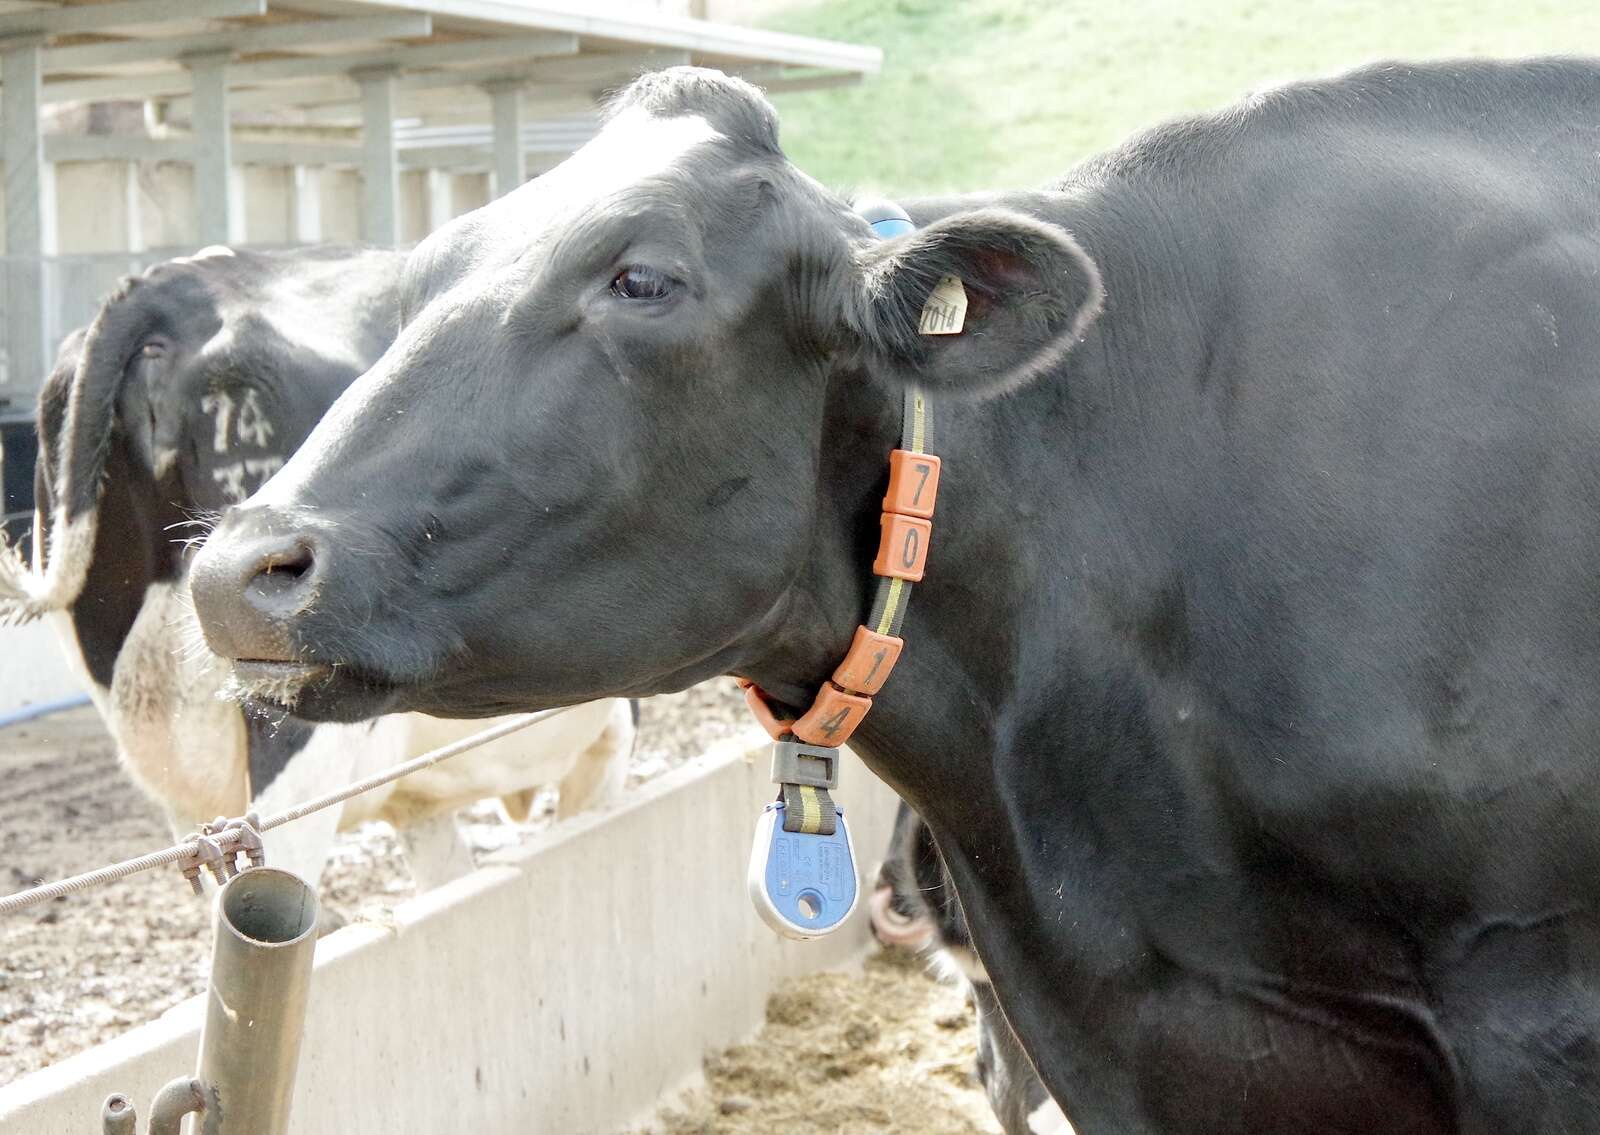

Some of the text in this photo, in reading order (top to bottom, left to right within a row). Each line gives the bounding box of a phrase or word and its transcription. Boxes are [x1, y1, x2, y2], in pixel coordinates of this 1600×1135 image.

[921, 305, 957, 331] 7014
[819, 464, 930, 739] 7 0 1 4
